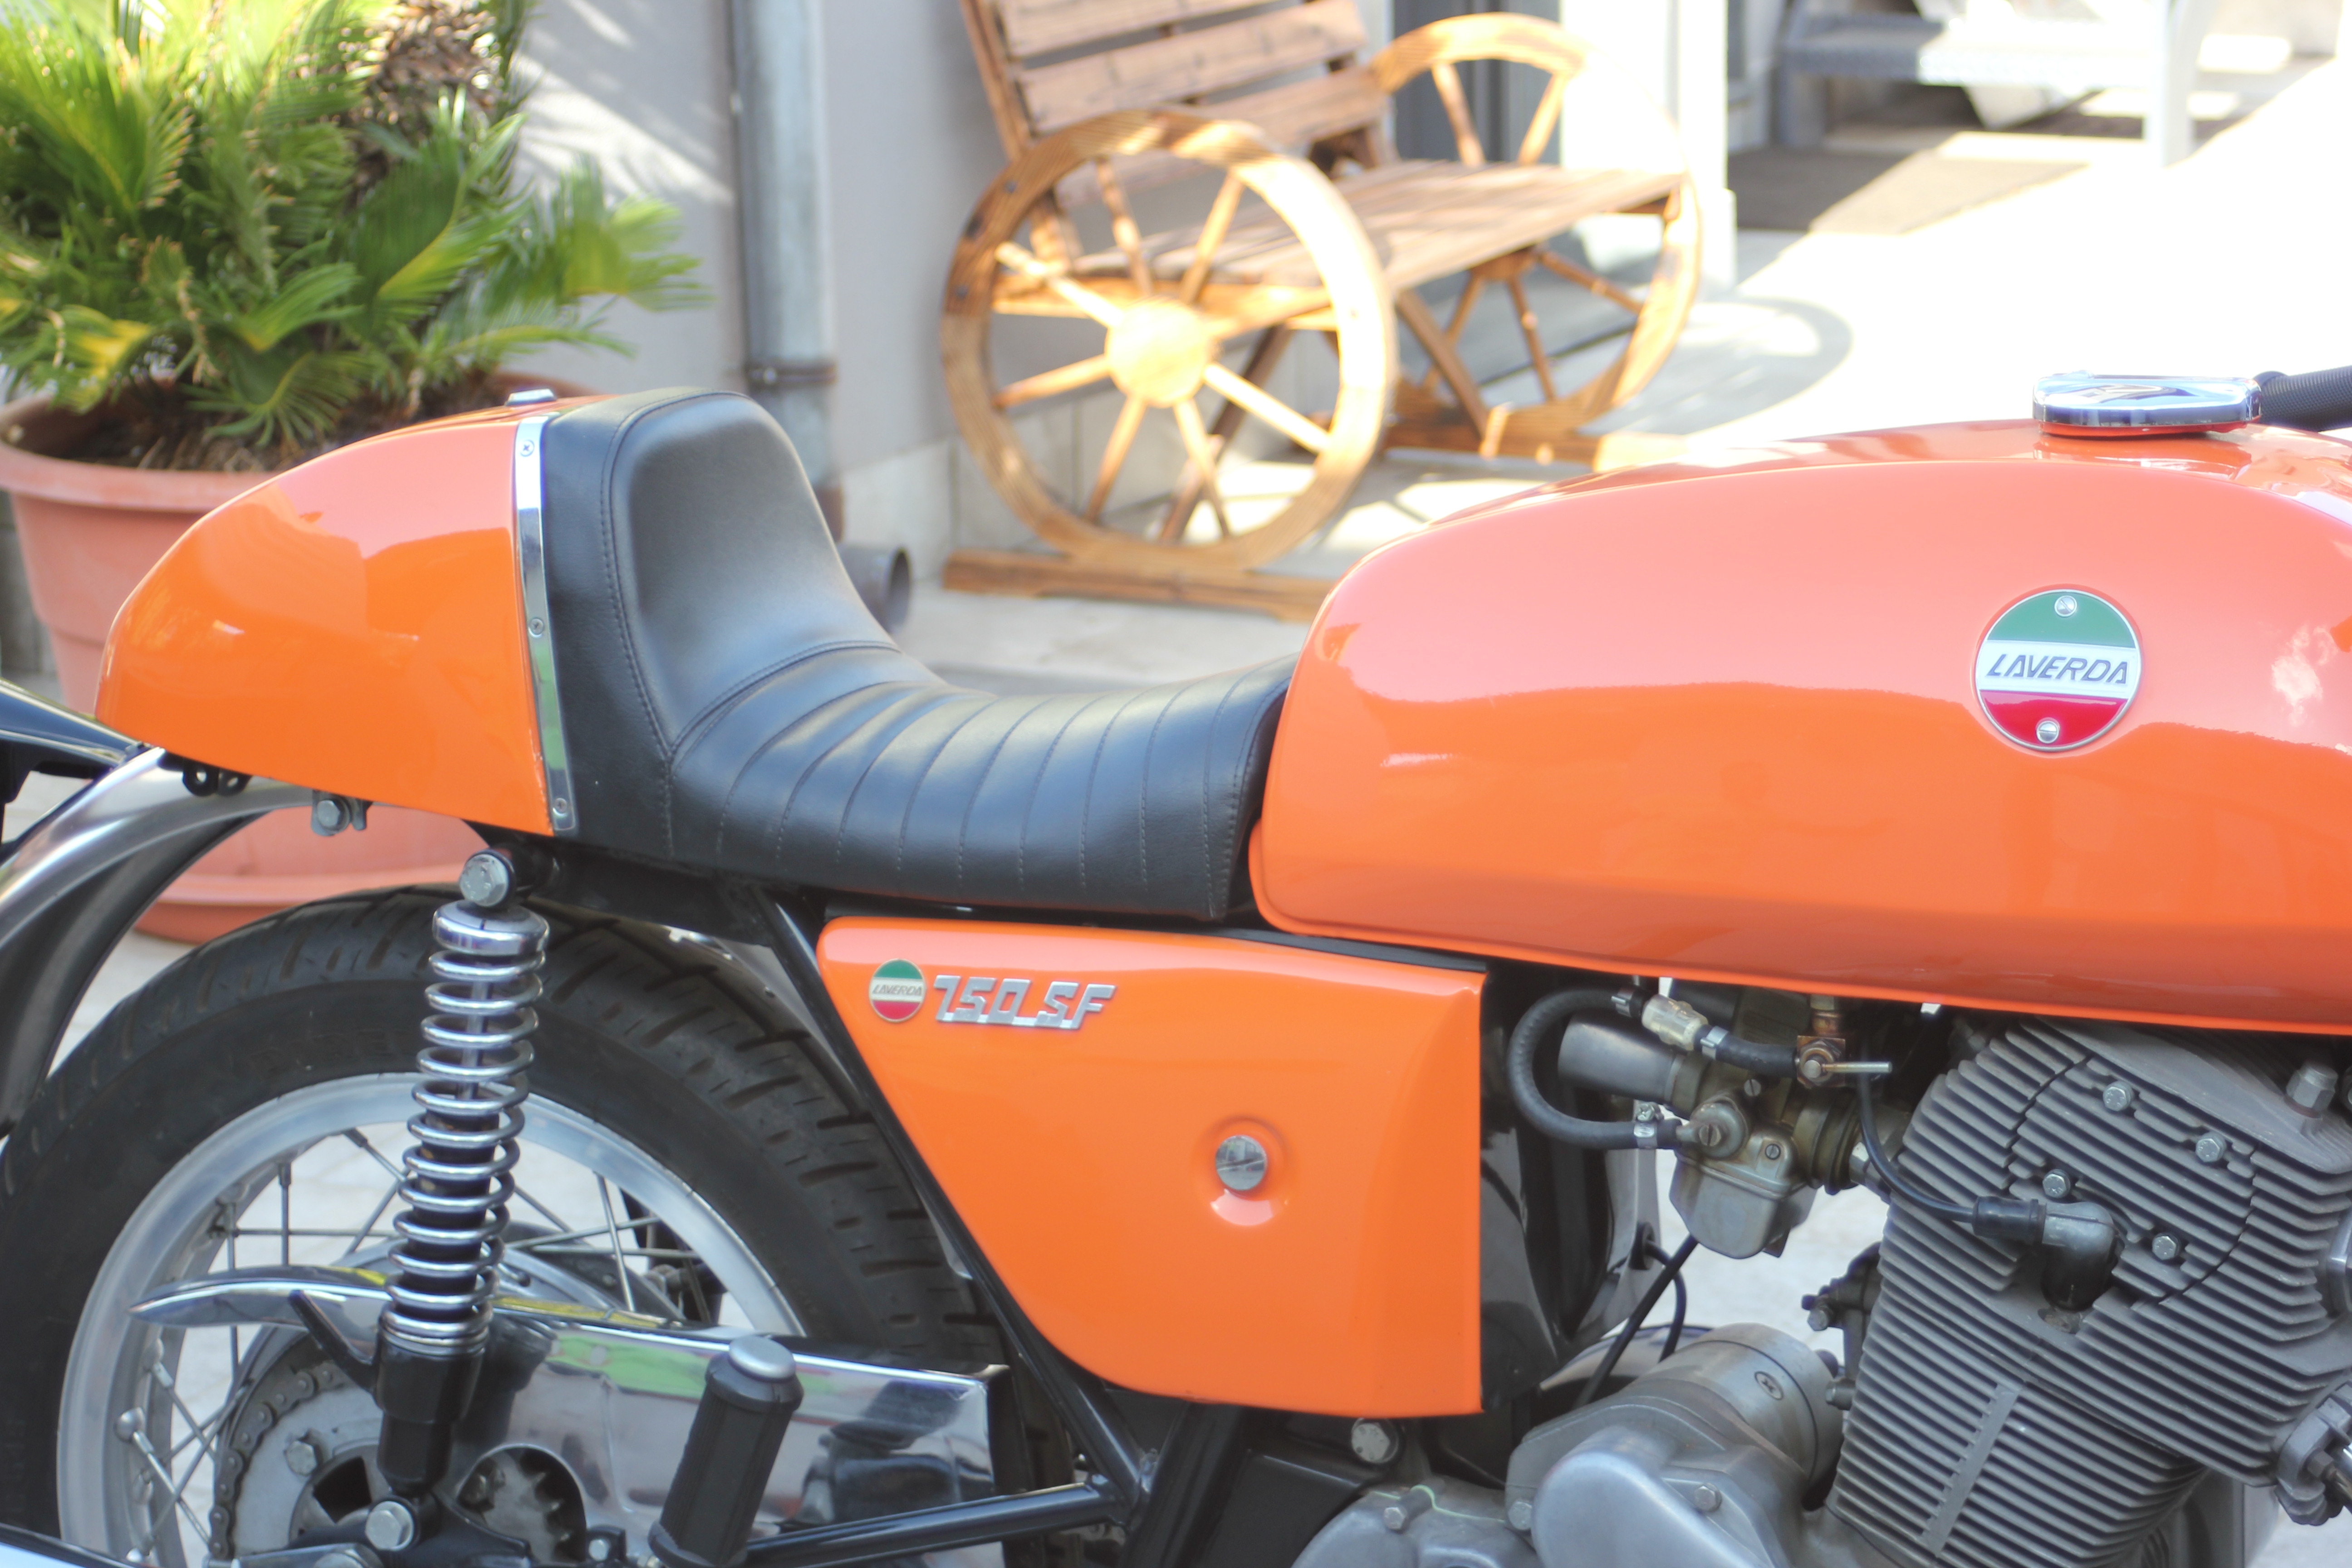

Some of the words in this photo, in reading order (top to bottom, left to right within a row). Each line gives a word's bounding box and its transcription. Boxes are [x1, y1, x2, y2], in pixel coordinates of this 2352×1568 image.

[1986, 654, 2128, 684] LAVERDA
[872, 984, 923, 996] LAVERDA
[933, 975, 1031, 1024] 750
[1035, 981, 1116, 1029] SF
